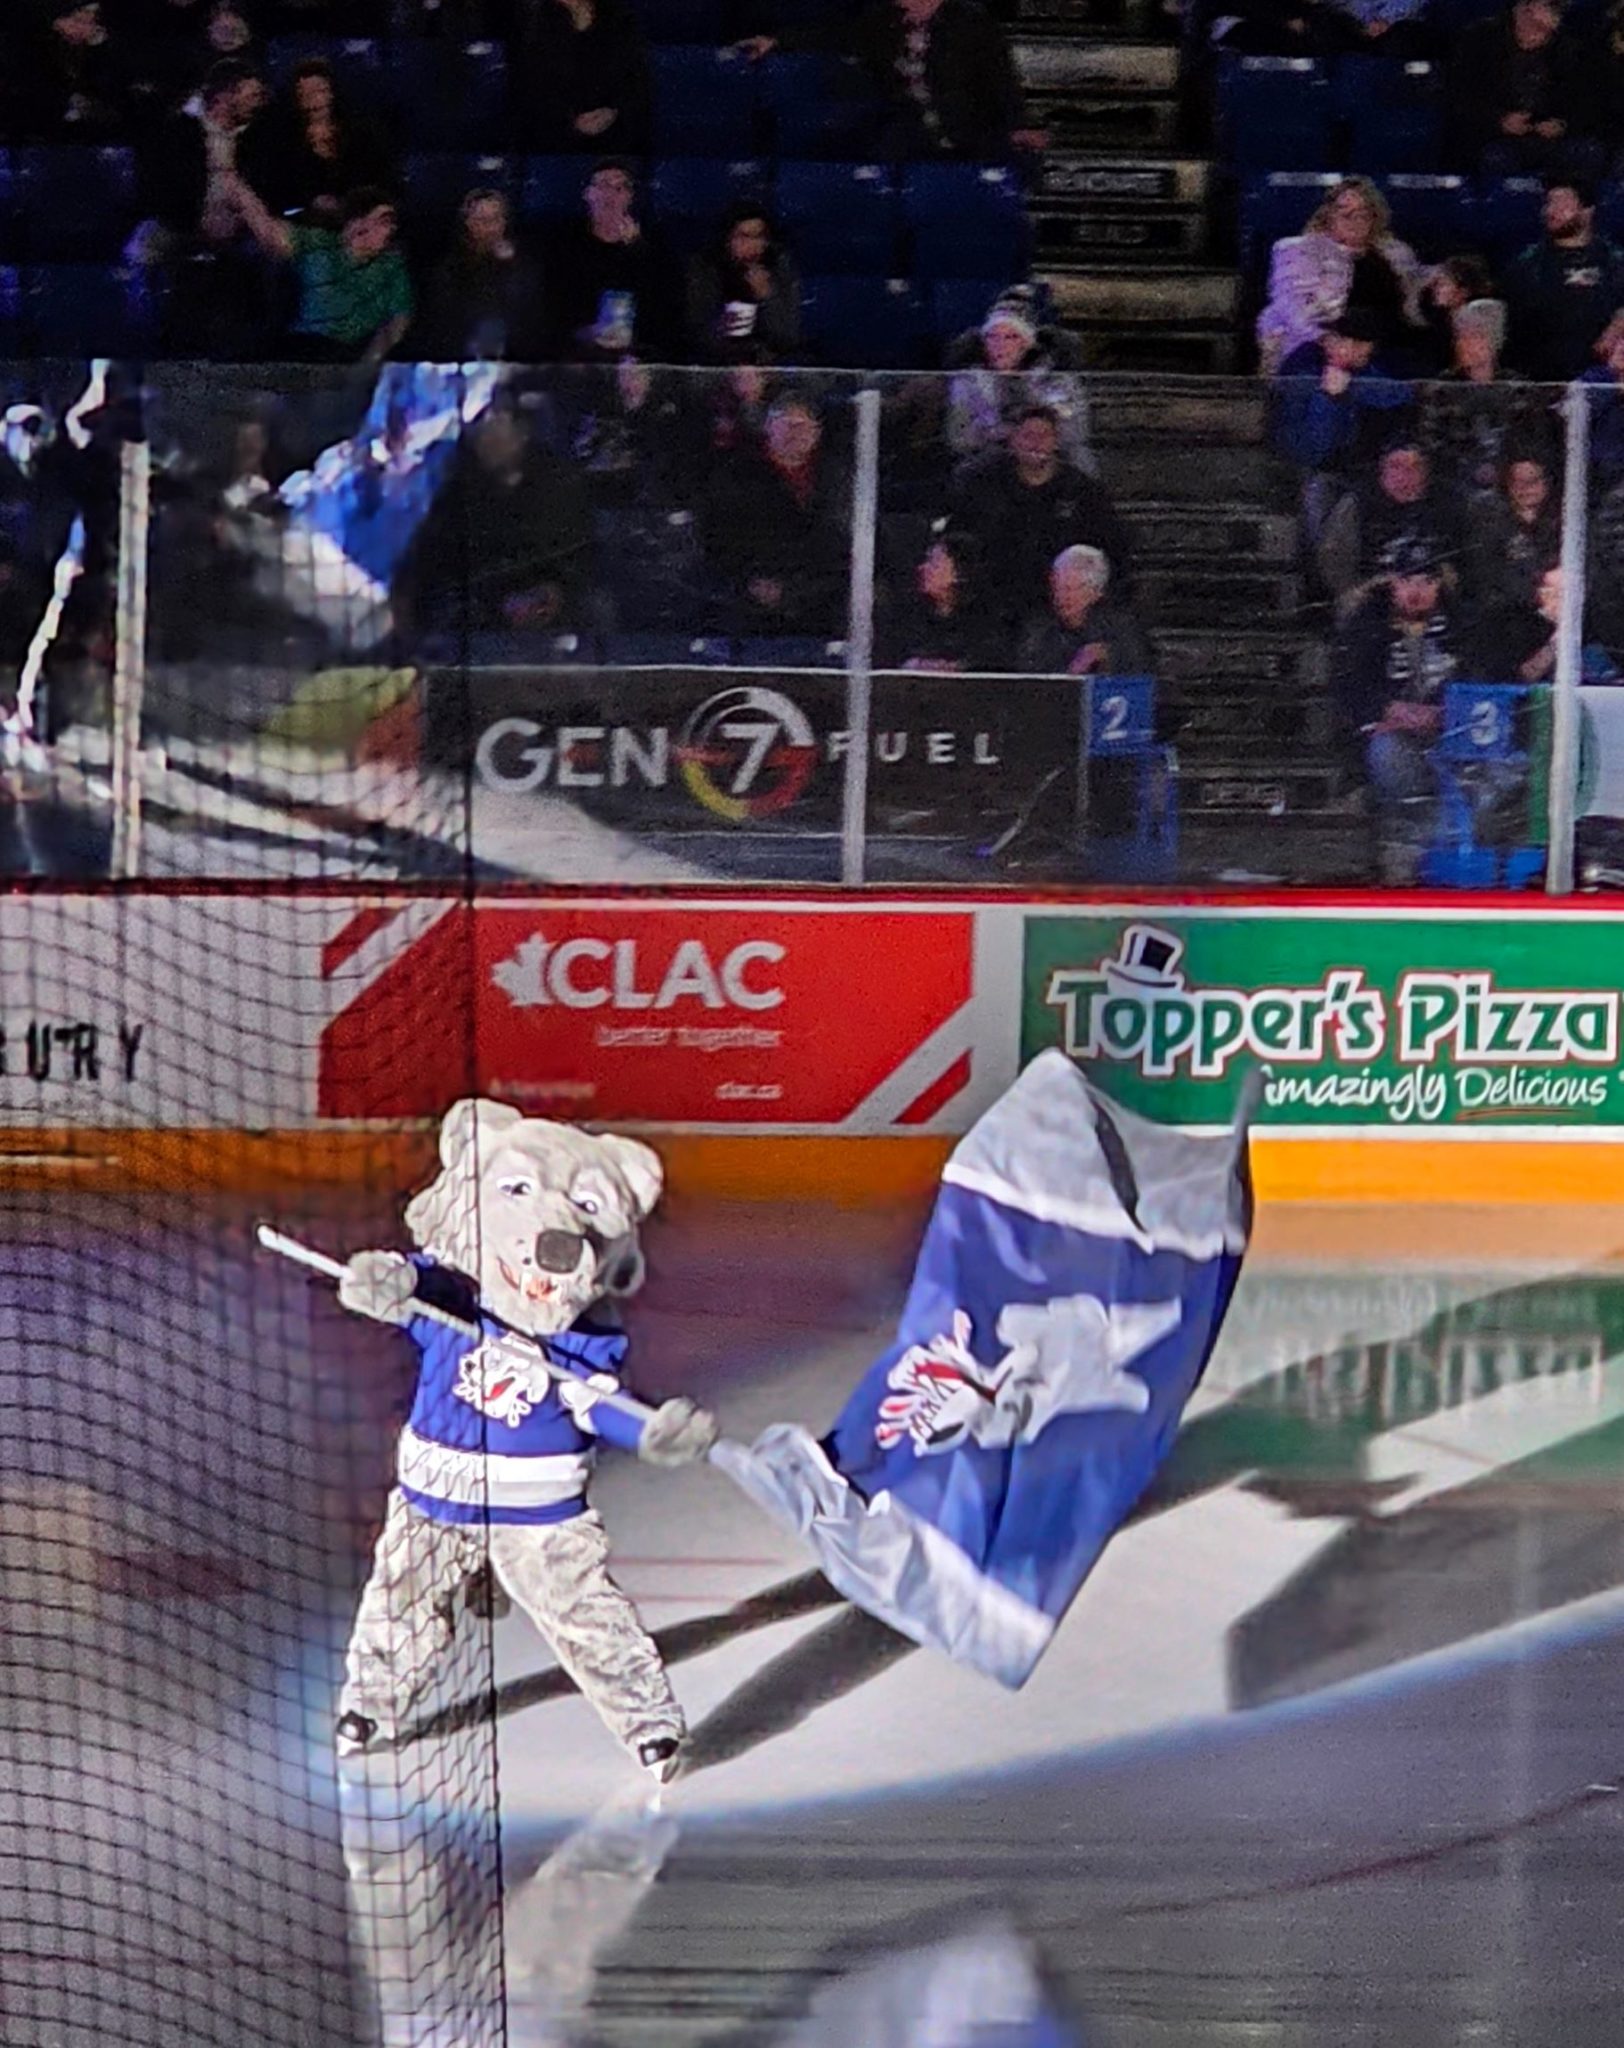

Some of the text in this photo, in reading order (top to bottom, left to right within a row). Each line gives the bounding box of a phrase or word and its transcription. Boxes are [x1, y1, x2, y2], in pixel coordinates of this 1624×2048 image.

[1100, 695, 1129, 740] 2
[1470, 700, 1499, 746] 3
[475, 716, 1000, 794] GEN 7 FUEL
[550, 937, 788, 1011] CLAC
[1046, 970, 1619, 1077] Topper's Pizza
[1453, 1064, 1608, 1107] Delicious
